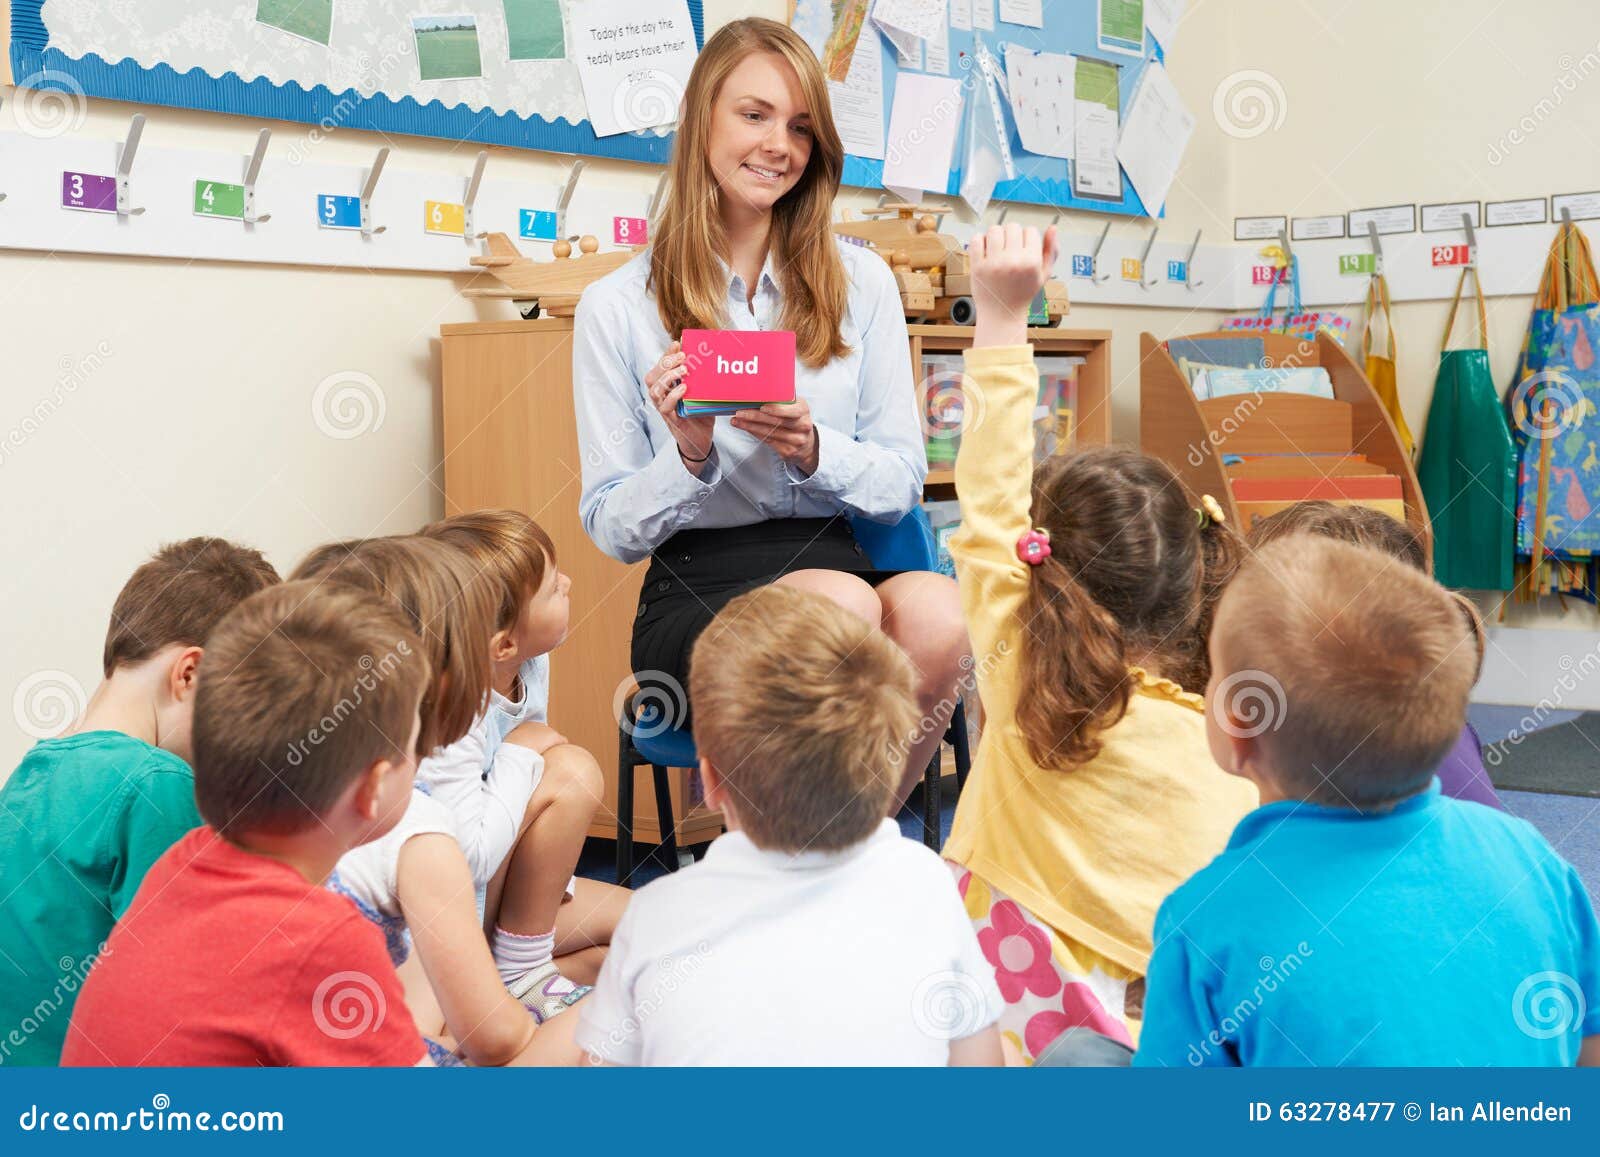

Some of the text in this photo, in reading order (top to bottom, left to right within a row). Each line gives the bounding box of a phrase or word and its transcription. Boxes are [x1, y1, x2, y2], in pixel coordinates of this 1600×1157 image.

[589, 18, 674, 41] Today's the day the
[587, 40, 685, 66] teddy bears have their
[70, 175, 84, 199] 3
[201, 183, 215, 206] 4
[325, 197, 337, 218] 5
[431, 203, 443, 224] 6
[526, 211, 536, 231] 7
[619, 219, 630, 237] 8
[1074, 256, 1085, 272] 15
[1342, 256, 1359, 270] 19
[1434, 247, 1454, 262] 20
[1170, 262, 1179, 276] 17
[1255, 266, 1271, 281] 18
[717, 355, 759, 375] had
